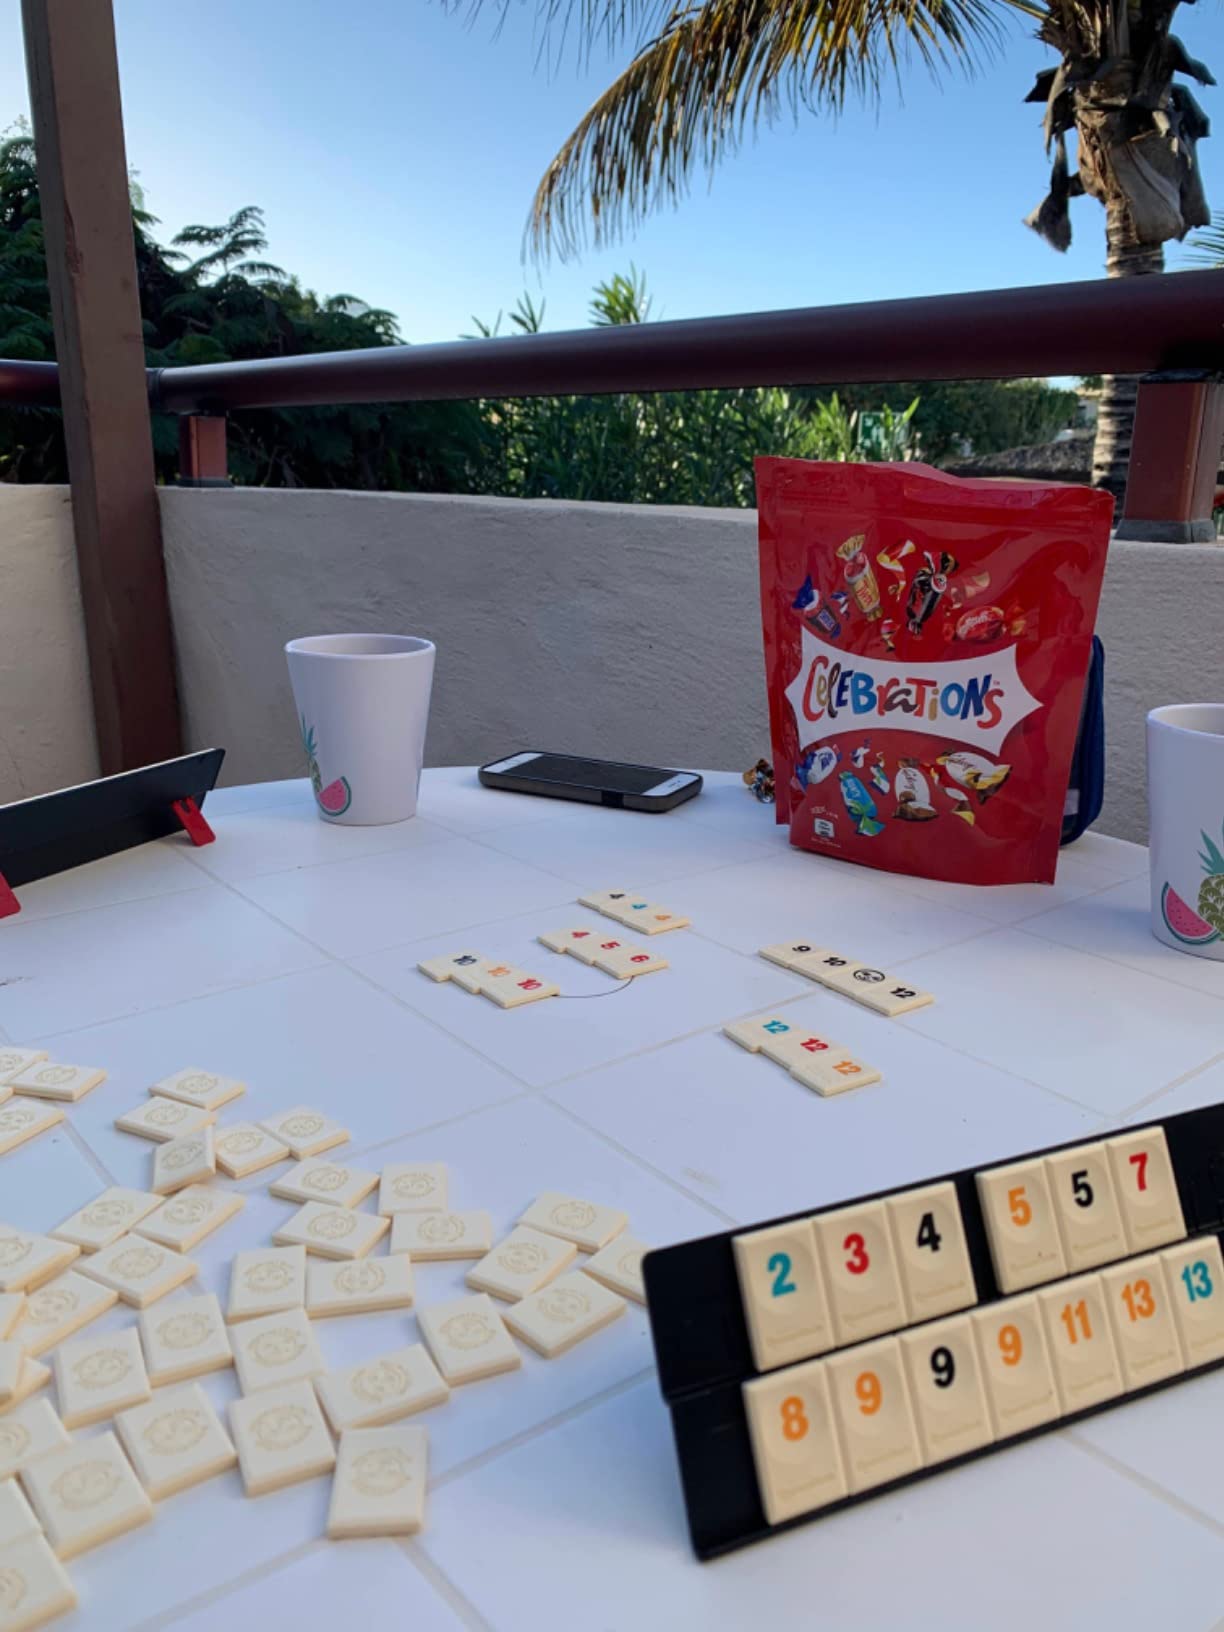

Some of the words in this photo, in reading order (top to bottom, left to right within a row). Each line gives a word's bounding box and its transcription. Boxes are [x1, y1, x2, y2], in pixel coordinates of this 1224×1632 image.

[453, 955, 477, 966] 10
[517, 978, 542, 990] 10
[600, 941, 621, 951] 5
[630, 954, 650, 963] 6
[791, 945, 812, 953] 9
[823, 956, 847, 967] 10
[890, 987, 917, 1000] 12
[762, 1020, 790, 1035] 12
[800, 1038, 829, 1053] 12
[832, 1060, 862, 1076] 12
[1007, 1186, 1033, 1226] 5
[1071, 1170, 1093, 1208] 5
[1128, 1152, 1149, 1191] 7
[767, 1253, 796, 1297] 2
[843, 1233, 870, 1275] 3
[916, 1212, 942, 1253] 4
[780, 1396, 809, 1441] 8
[855, 1371, 883, 1416] 9
[930, 1346, 956, 1389] 9
[997, 1324, 1023, 1367] 9
[1061, 1299, 1093, 1345] 11
[1121, 1278, 1156, 1322] 13
[1182, 1260, 1213, 1303] 13
